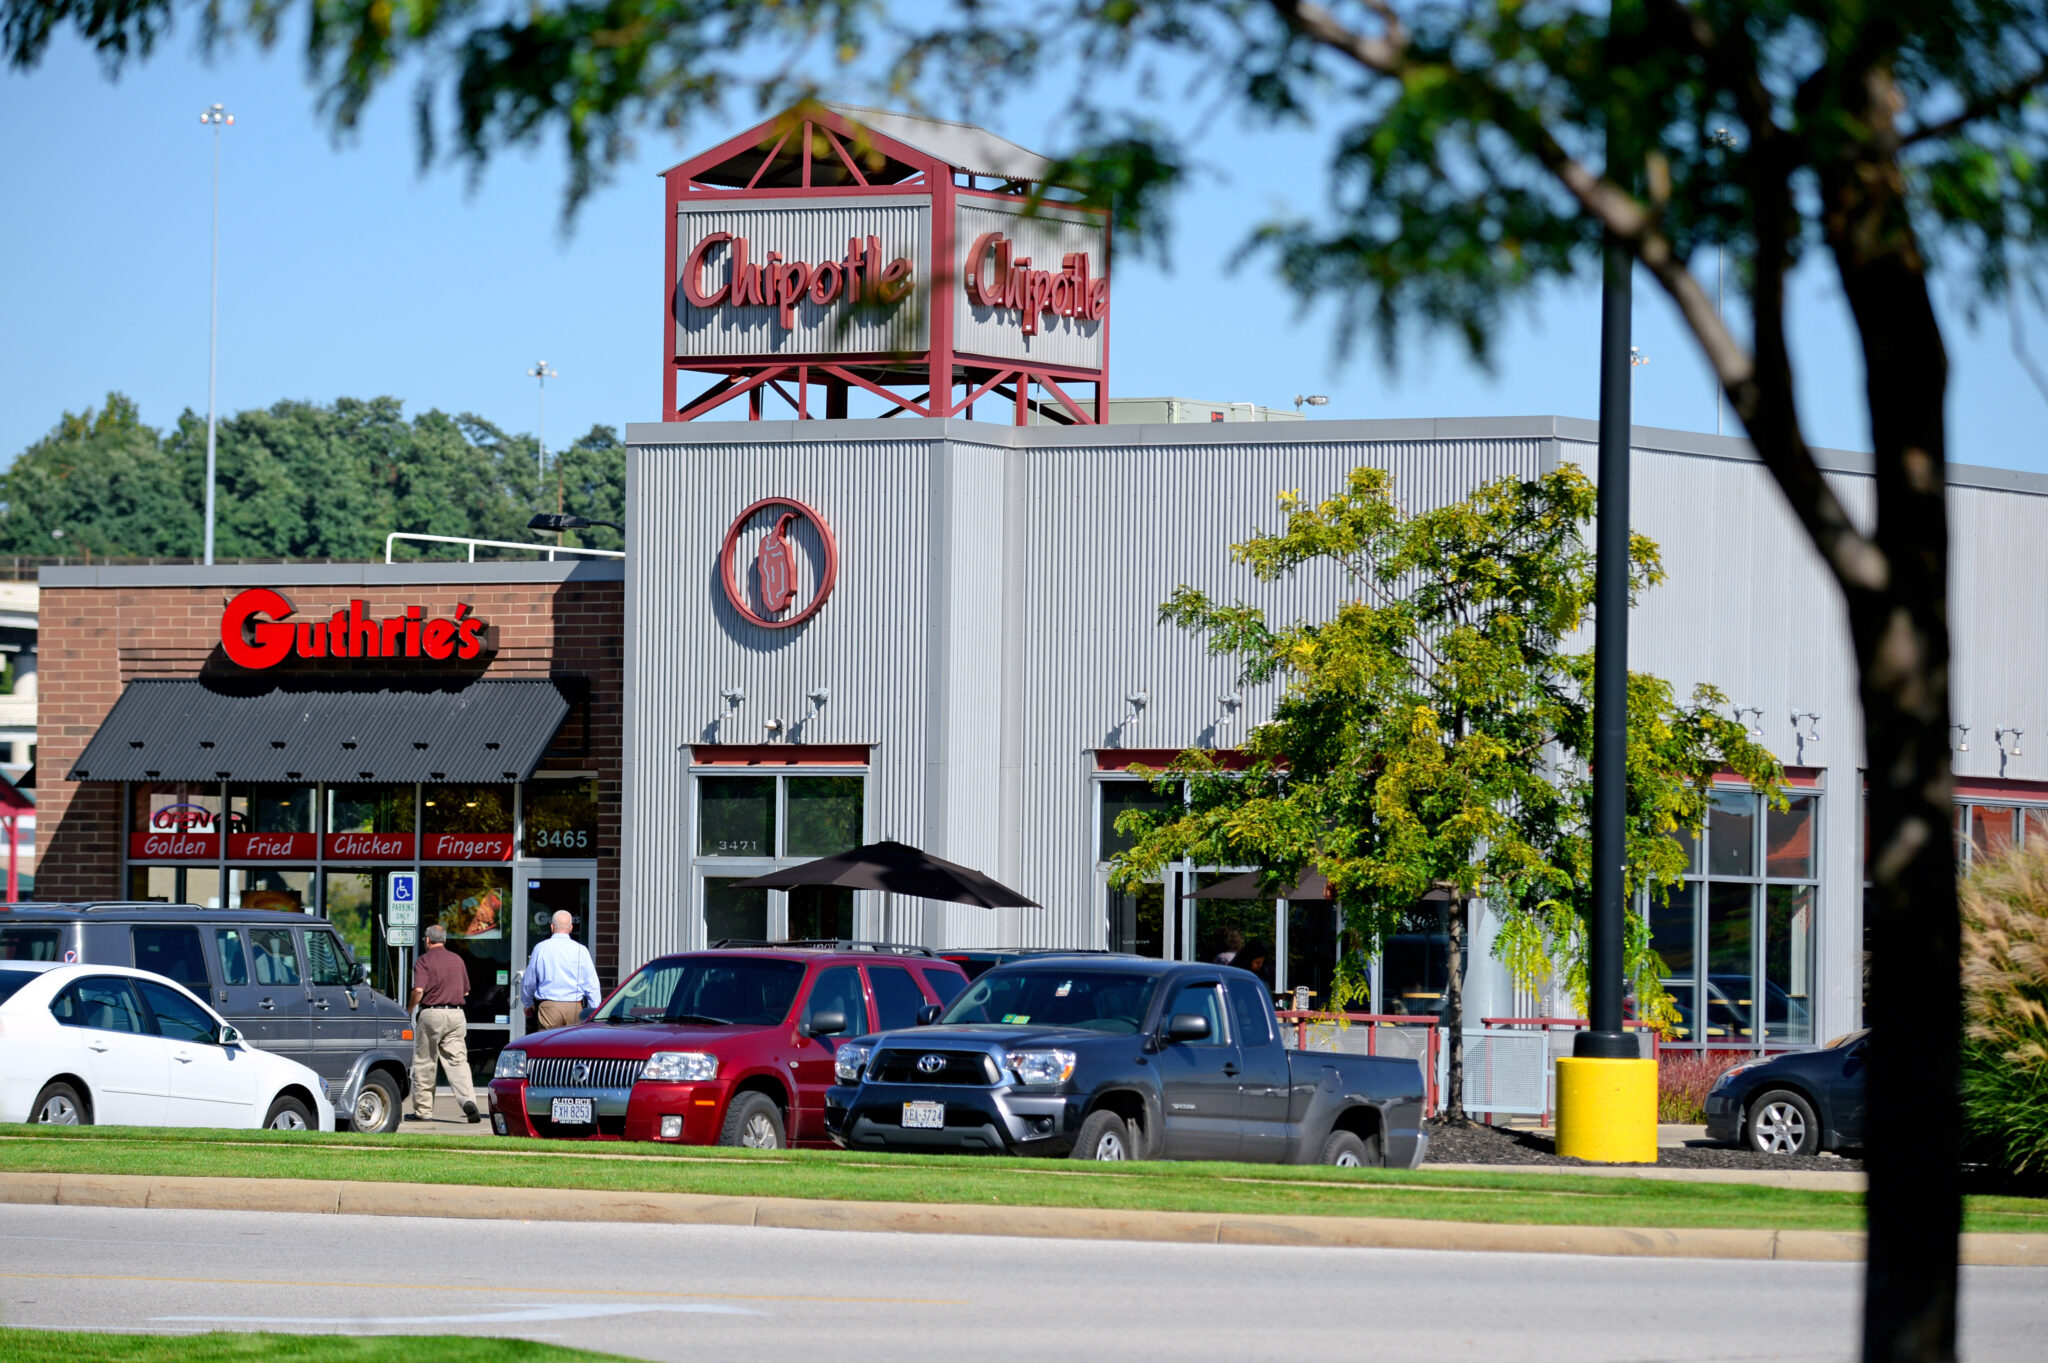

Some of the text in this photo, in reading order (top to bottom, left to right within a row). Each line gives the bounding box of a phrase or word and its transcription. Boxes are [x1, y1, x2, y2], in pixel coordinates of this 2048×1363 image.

[683, 232, 915, 330] Chipotle
[965, 232, 1110, 336] Chipotle
[221, 588, 486, 669] Guthrie's
[155, 811, 211, 829] OPEN
[144, 835, 206, 855] Golden
[246, 835, 294, 856] Fried
[334, 835, 402, 854] Chicken
[436, 835, 502, 859] Fingers
[536, 830, 588, 848] 3465
[719, 840, 756, 850] 3471
[392, 903, 414, 912] PARKING
[554, 1106, 590, 1118] FXH 8253
